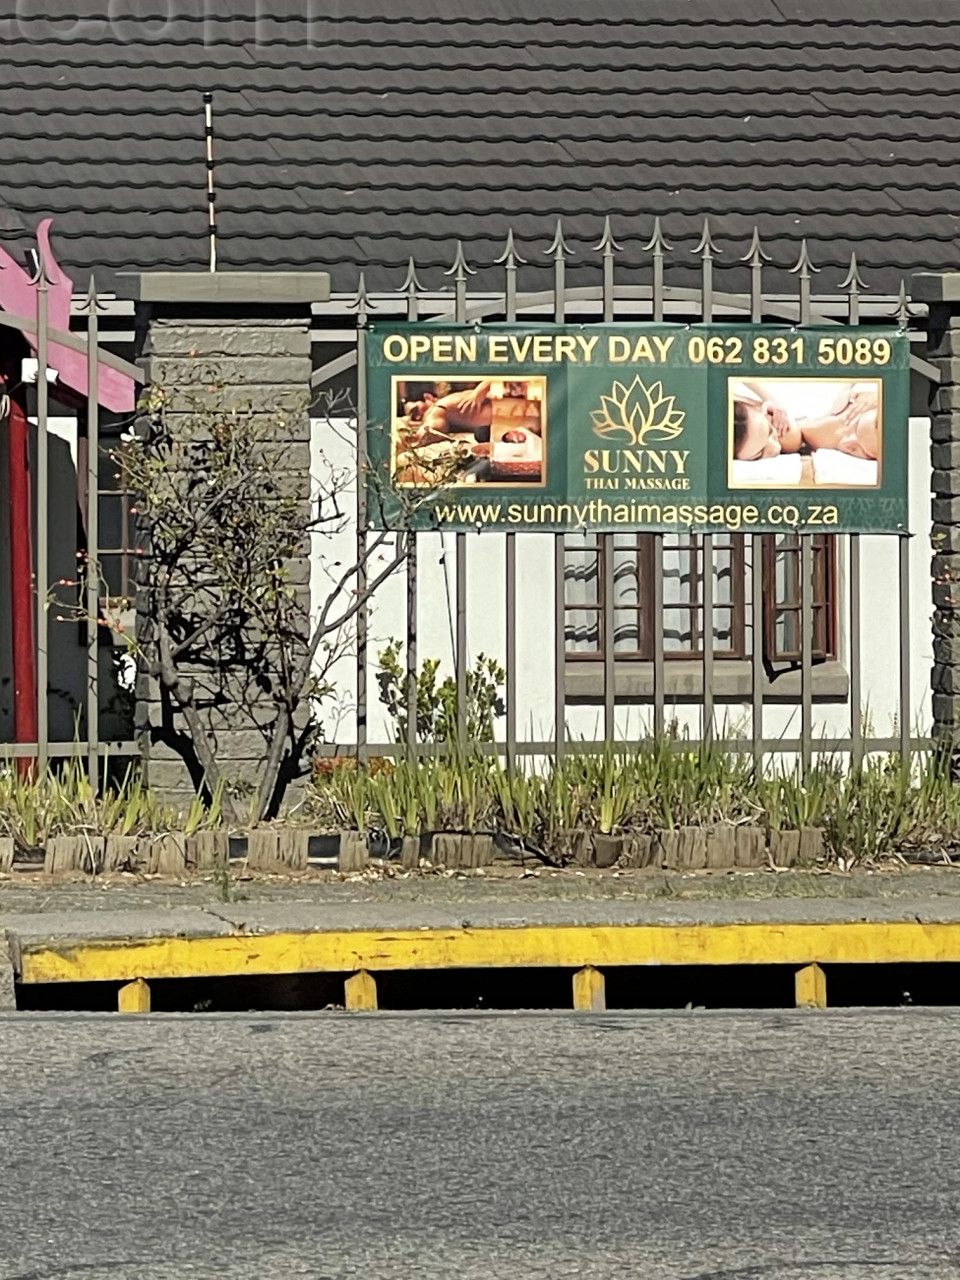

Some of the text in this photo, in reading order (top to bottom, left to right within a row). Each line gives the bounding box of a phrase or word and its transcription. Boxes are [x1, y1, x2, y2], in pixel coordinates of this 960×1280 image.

[382, 334, 891, 366] OPEN EVERY DAY 062 831 5089
[583, 449, 691, 474] SUNNY
[584, 477, 691, 490] THAI MASSAGE
[435, 498, 839, 526] www.sunnythaimassage.co.za
